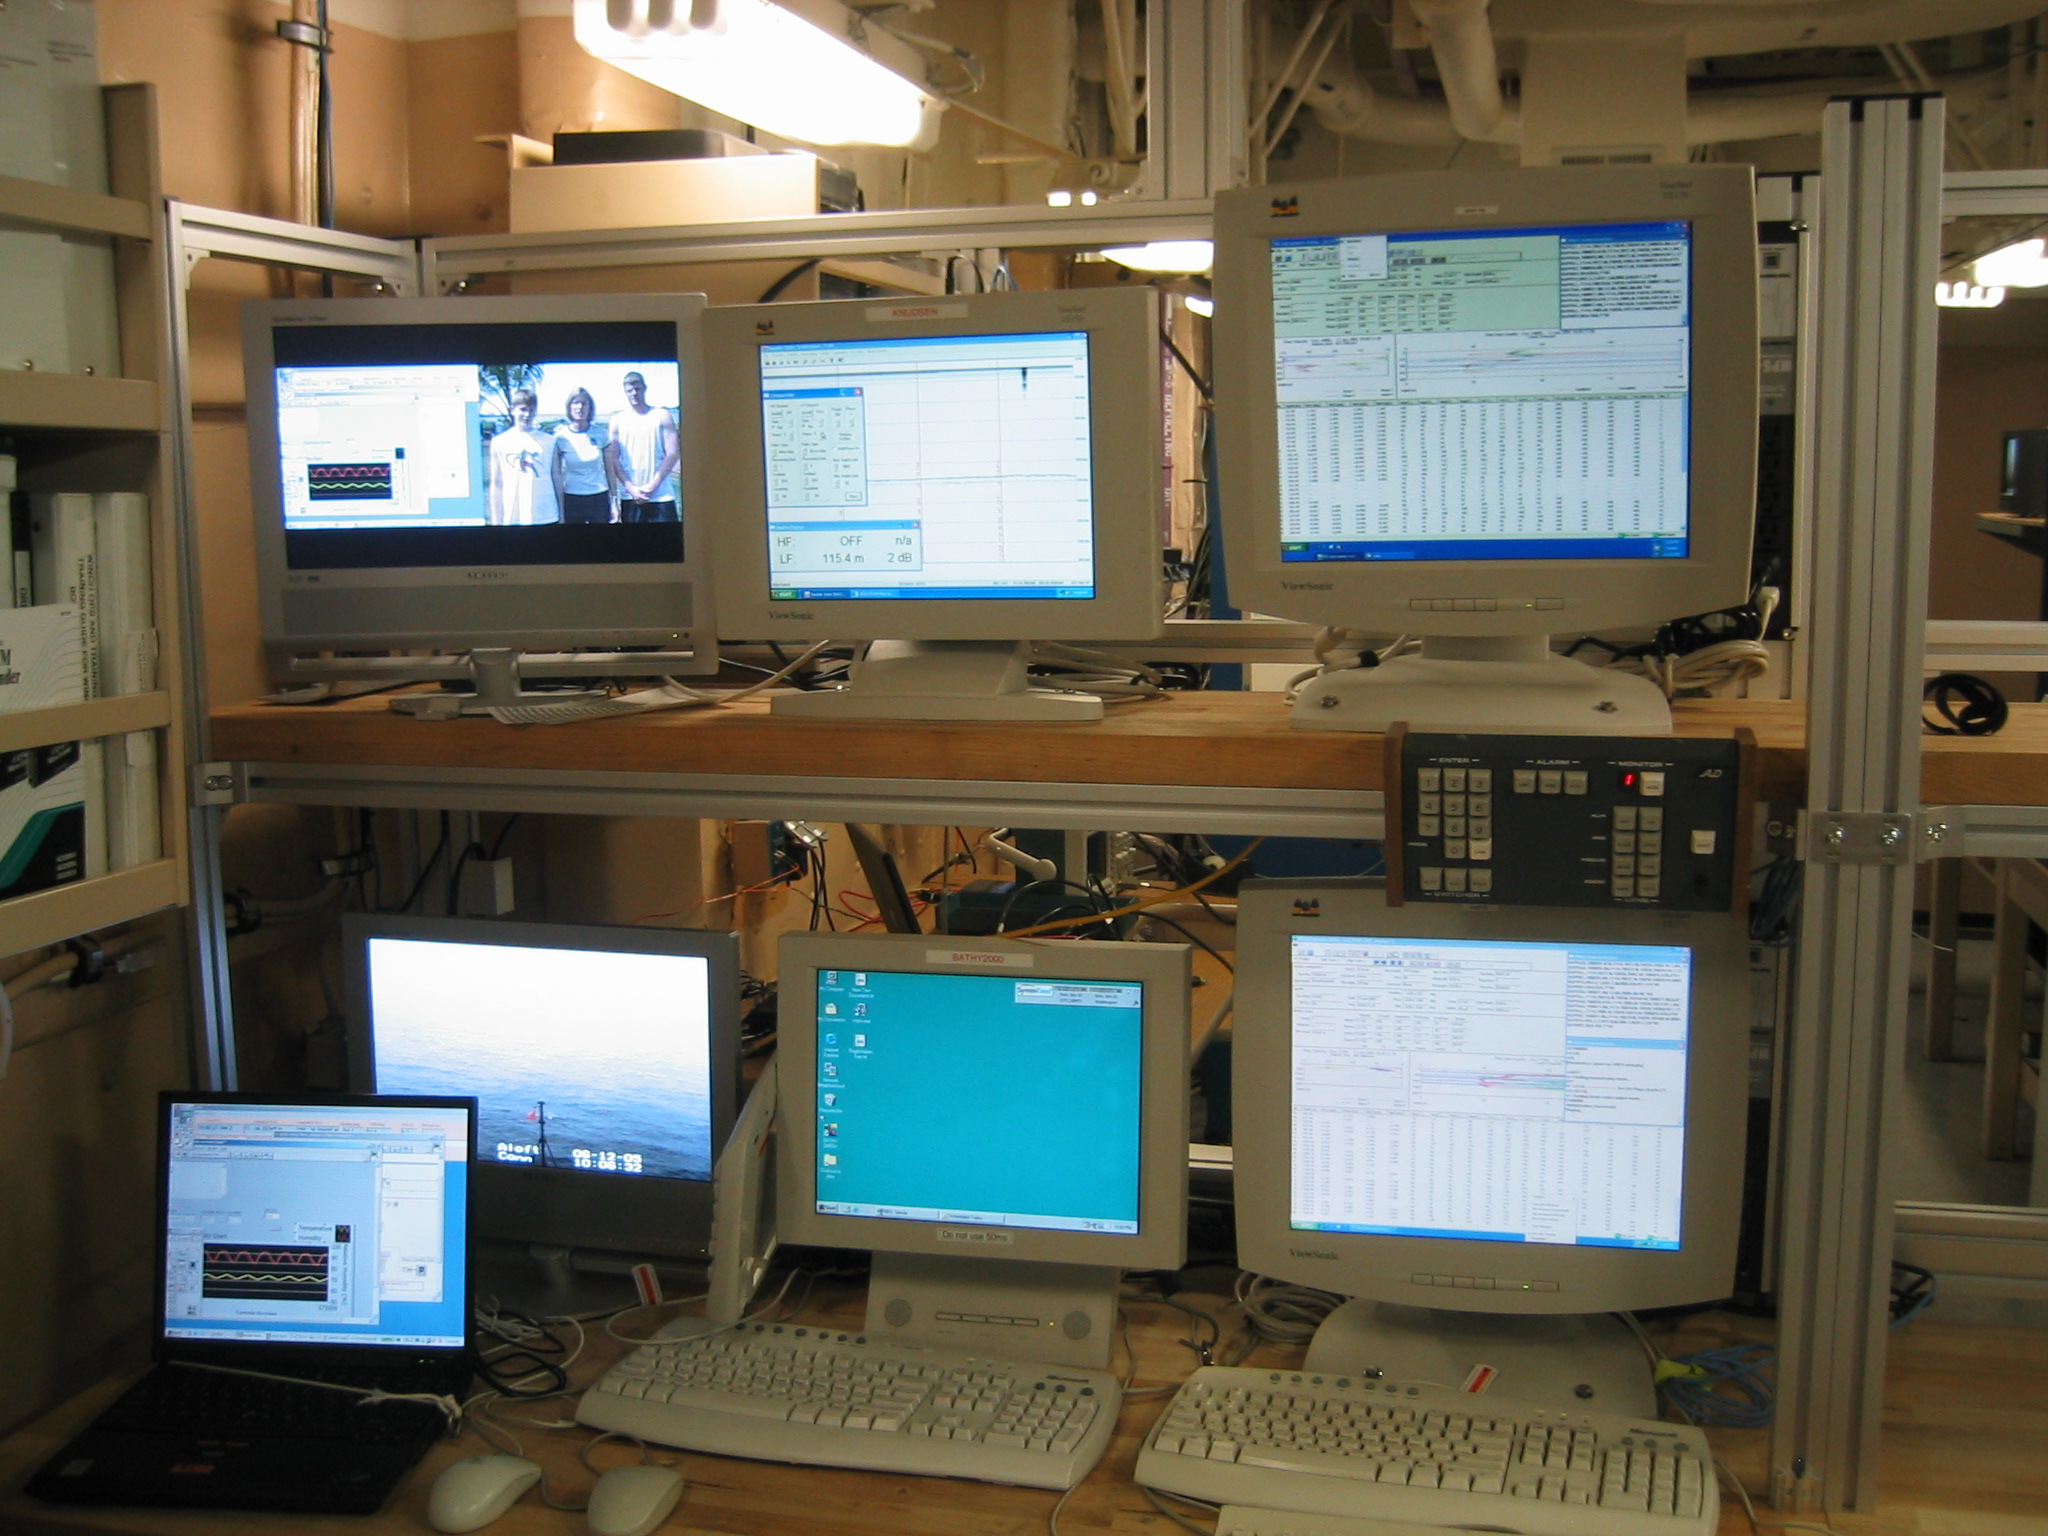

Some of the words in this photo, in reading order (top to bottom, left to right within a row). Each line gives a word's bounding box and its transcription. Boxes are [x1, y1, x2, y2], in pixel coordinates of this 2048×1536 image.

[840, 535, 863, 546] OFF
[895, 535, 913, 545] n/a
[822, 553, 851, 564] 115.4
[854, 555, 864, 563] m
[887, 553, 895, 563] 2
[898, 553, 913, 563] dB
[1618, 760, 1664, 768] MONITOR
[952, 953, 1005, 963] BATHY2000
[497, 1143, 539, 1155] Aloft
[497, 1151, 533, 1163] Conn
